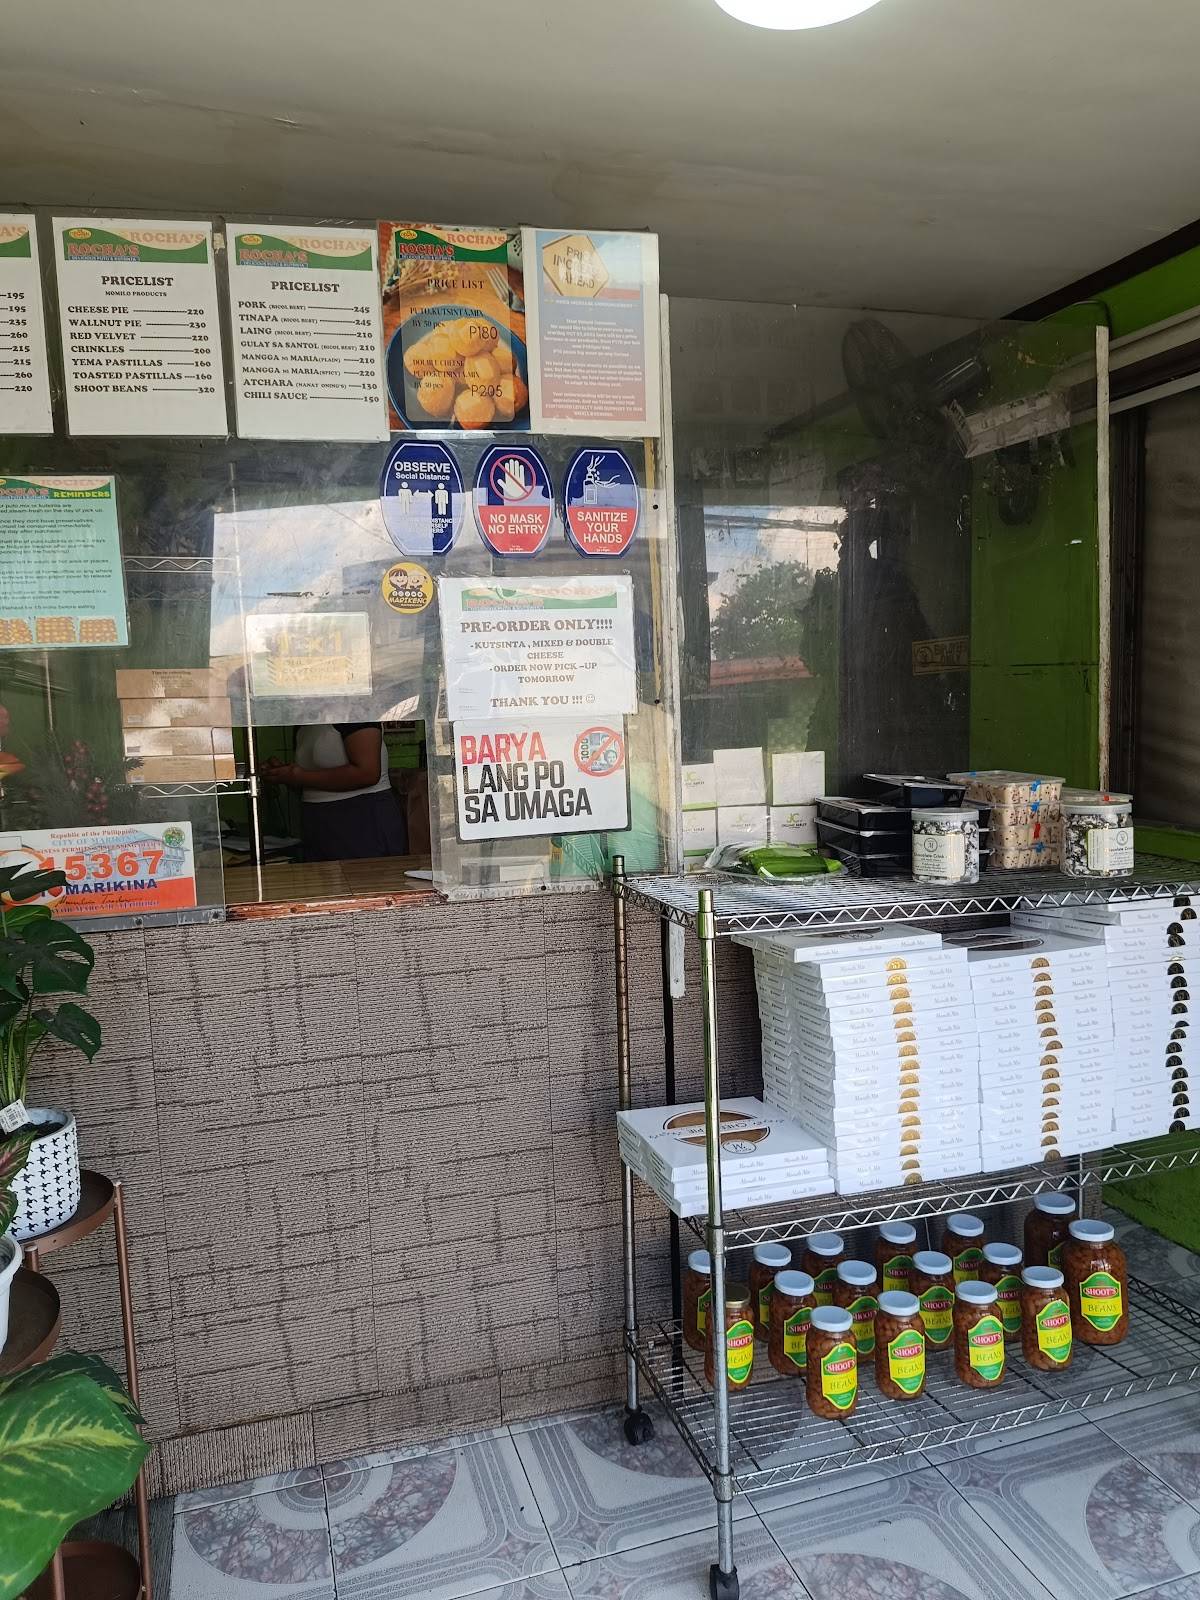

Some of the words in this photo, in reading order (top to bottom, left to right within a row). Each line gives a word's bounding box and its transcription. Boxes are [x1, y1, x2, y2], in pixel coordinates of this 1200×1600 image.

[447, 233, 506, 245] ROCHA'S
[400, 243, 454, 256] ROCHA'S
[101, 276, 174, 286] PRICELIST
[428, 279, 458, 289] PRICE
[462, 280, 485, 289] LIST
[270, 281, 340, 293] PRICELIST
[68, 306, 109, 314] CHEESE
[111, 306, 129, 314] PIE
[238, 301, 267, 309] PORK
[69, 319, 122, 327] WALLNUT
[239, 314, 278, 322] TINAPA
[70, 332, 92, 340] RED
[240, 327, 272, 335] LAING
[469, 326, 498, 340] P180
[71, 345, 125, 353] CRINKLES
[105, 359, 163, 367] PASTILLAS
[73, 372, 123, 380] TOASTED
[125, 372, 183, 380] PASTILLAS
[243, 379, 293, 387] ATCHARA
[74, 385, 110, 393] SHOOT
[113, 385, 148, 393] BEANS
[471, 385, 503, 398] P205
[274, 392, 308, 400] SAUCE
[394, 461, 451, 473] OBSERVE
[395, 472, 418, 480] Social
[419, 473, 451, 481] Distance
[490, 514, 507, 524] NO
[509, 514, 543, 524] MASK
[577, 511, 628, 522] SANITIZE
[488, 525, 505, 534] NO
[508, 525, 545, 535] ENTRY
[587, 522, 619, 533] YOUR
[583, 533, 623, 544] HANDS
[461, 620, 551, 633] PRE-ORDER
[554, 619, 613, 632] ONLY!!!!
[532, 639, 563, 648] MIXED
[575, 638, 614, 648] DOUBLE
[527, 651, 564, 660] CHEESE
[529, 663, 552, 672] NOW
[554, 663, 578, 671] PICK
[517, 674, 575, 684] TOMORROW
[490, 697, 539, 708] THANK
[540, 695, 570, 706] YOU
[460, 732, 547, 765] BARYA
[462, 762, 529, 795] LANG
[534, 760, 565, 790] PO
[465, 794, 500, 824] SA
[504, 787, 593, 821] UMAGA
[65, 878, 158, 896] MARIKINA
[1085, 1288, 1117, 1296] SHOOT'S
[923, 1300, 952, 1310] SHOOT'S
[1088, 1304, 1118, 1313] BEANS
[974, 1333, 1001, 1345] SHOOT'S
[895, 1345, 923, 1357] SHOOT'S
[828, 1359, 856, 1372] SHOOT'S
